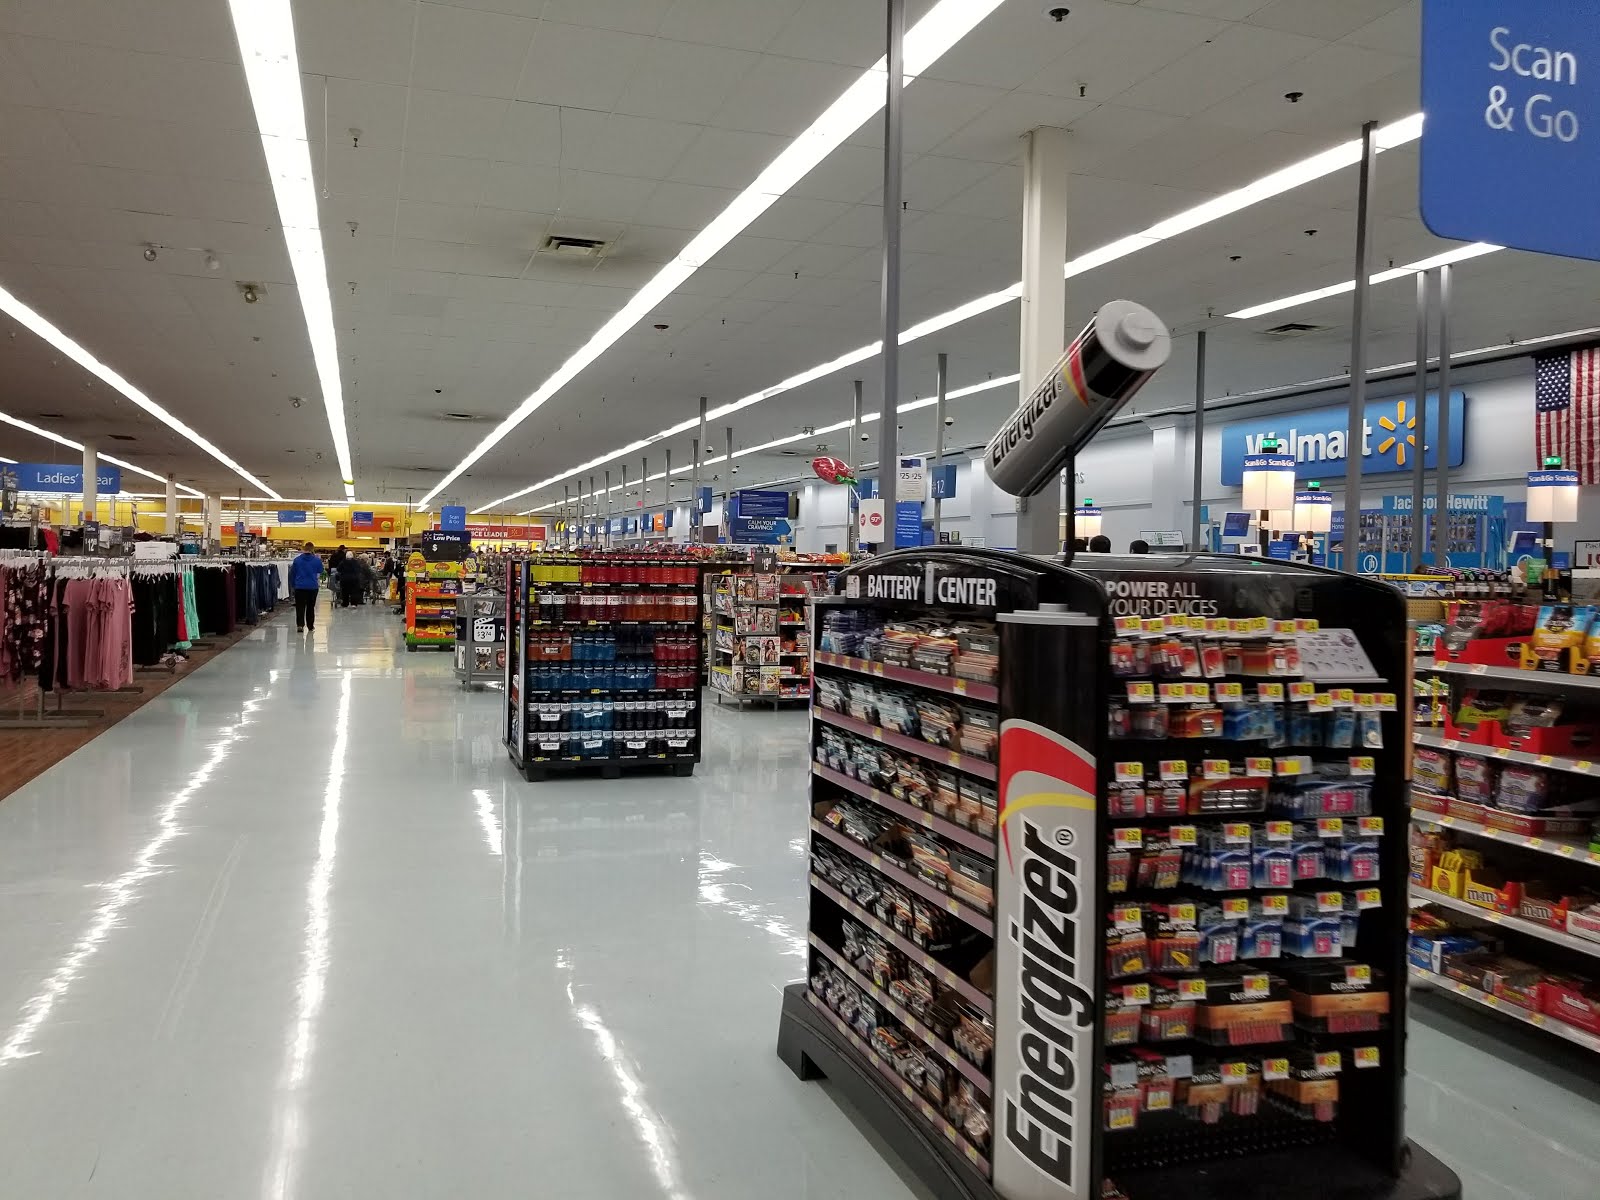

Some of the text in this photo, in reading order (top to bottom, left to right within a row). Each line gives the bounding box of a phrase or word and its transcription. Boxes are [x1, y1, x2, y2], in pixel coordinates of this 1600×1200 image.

[1488, 26, 1577, 85] Scan
[1484, 85, 1579, 142] & Go
[991, 371, 1059, 468] Energizer
[1245, 418, 1373, 463] Walmat
[1268, 459, 1295, 467] Scan&Go
[36, 472, 114, 486] Ladies' ear
[936, 480, 944, 494] 12
[1446, 494, 1488, 510] Hewitt
[867, 574, 997, 606] BATTERY CENTER
[1106, 580, 1202, 598] POWER ALL
[1108, 599, 1218, 616] YOUR DEVICES
[1003, 814, 1094, 1194] Energizer
